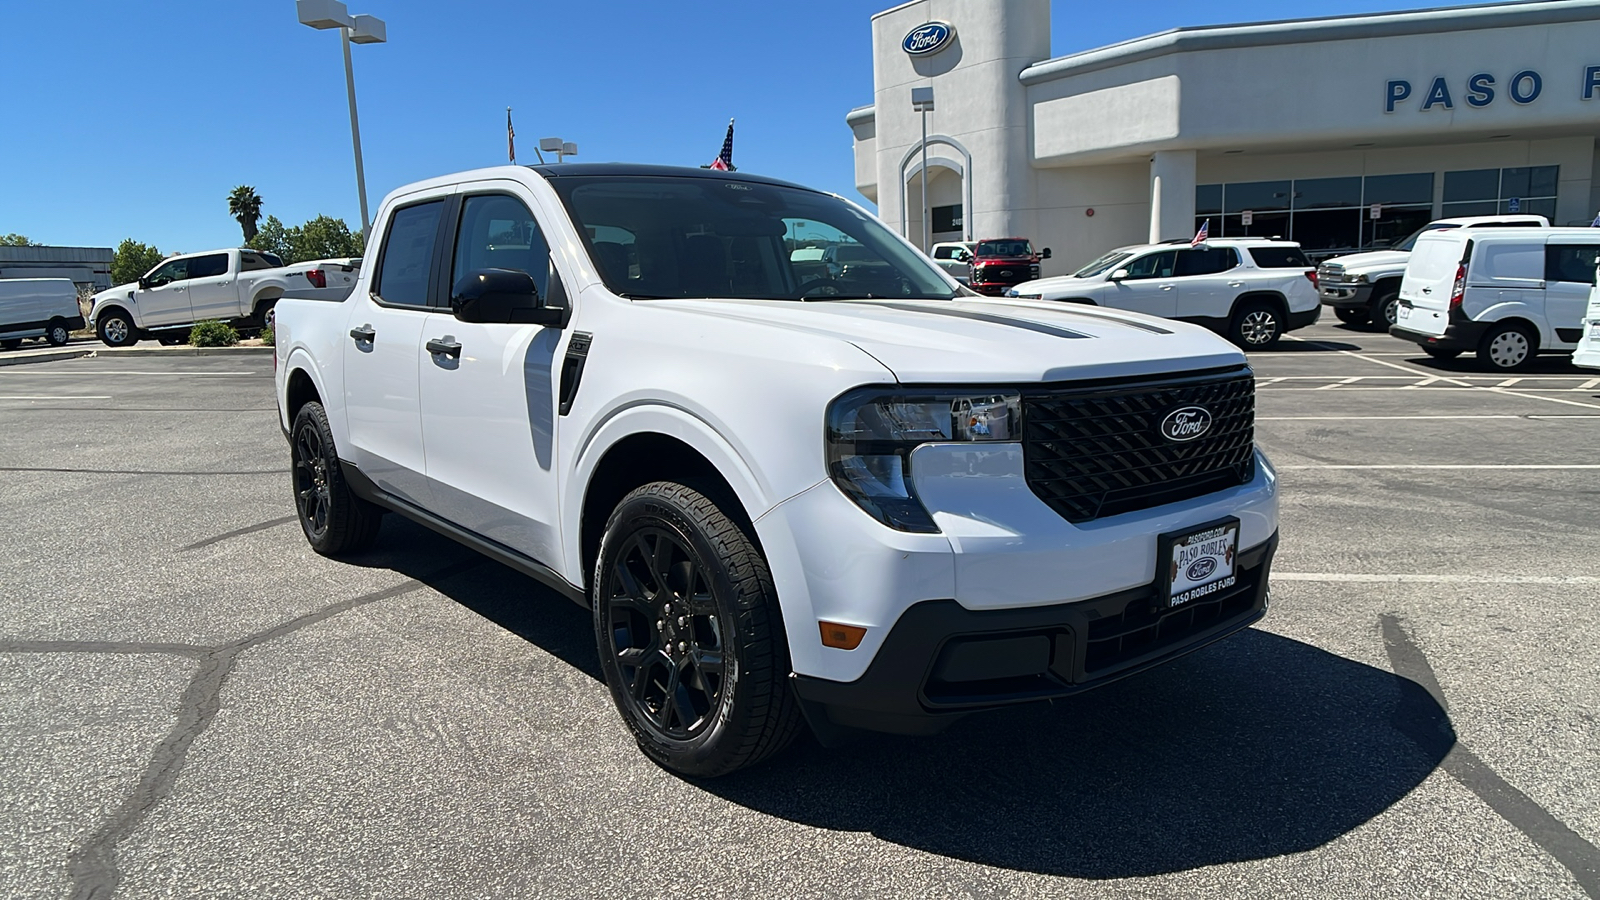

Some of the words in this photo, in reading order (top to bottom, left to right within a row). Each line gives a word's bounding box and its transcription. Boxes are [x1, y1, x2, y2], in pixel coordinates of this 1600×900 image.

[911, 28, 940, 50] Ford
[1384, 69, 1544, 114] PASO
[1171, 411, 1204, 436] Ford
[1179, 546, 1198, 569] PASO
[1200, 538, 1228, 557] ROBLES
[1192, 560, 1212, 578] Ford
[1171, 593, 1190, 607] PASO
[1190, 582, 1217, 599] ROBLES
[1218, 576, 1236, 592] FORD
